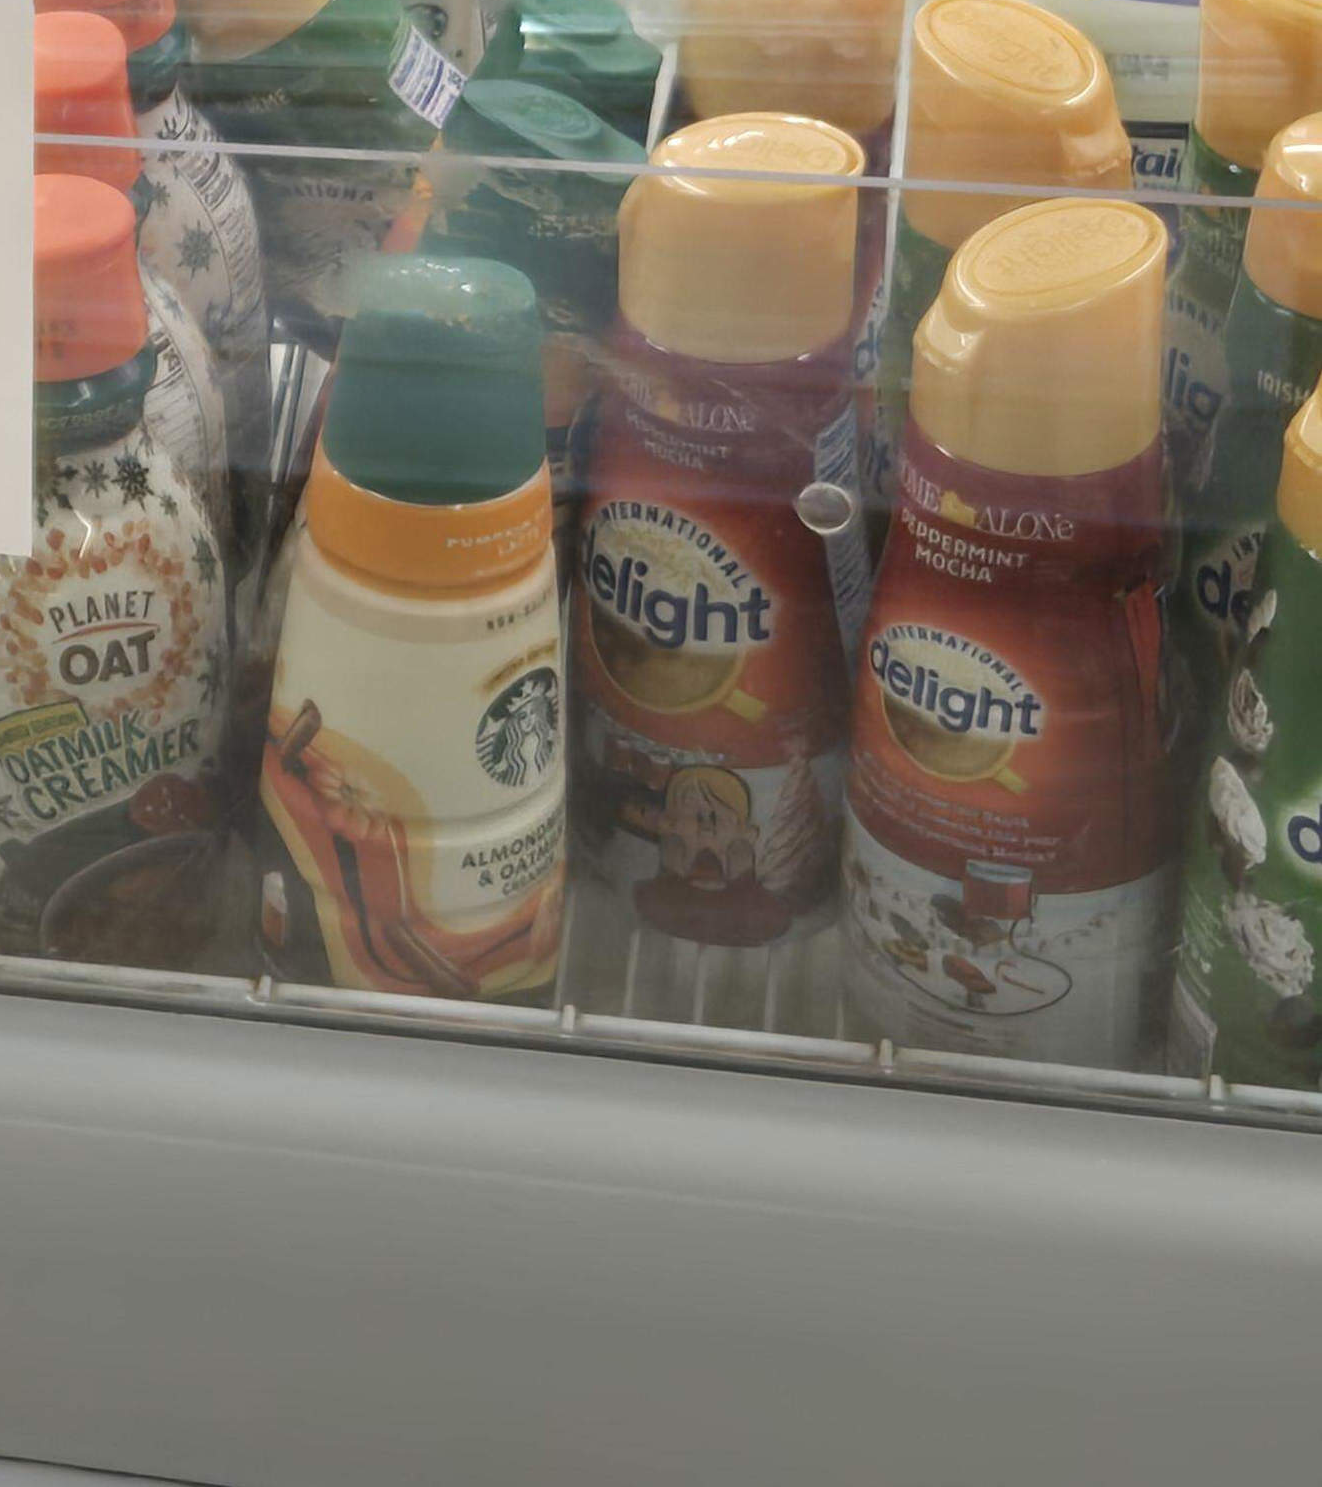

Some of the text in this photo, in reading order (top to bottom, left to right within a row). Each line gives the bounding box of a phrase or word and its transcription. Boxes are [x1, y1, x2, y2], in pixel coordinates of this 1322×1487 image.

[902, 507, 1028, 570] PEPPERMINT
[915, 544, 994, 584] MOCHA
[49, 589, 156, 635] PLANET
[587, 521, 772, 650] elight
[59, 629, 156, 686] OAT
[870, 639, 1042, 736] delight
[3, 711, 147, 784] OATMILK
[22, 717, 201, 821] CREAMER
